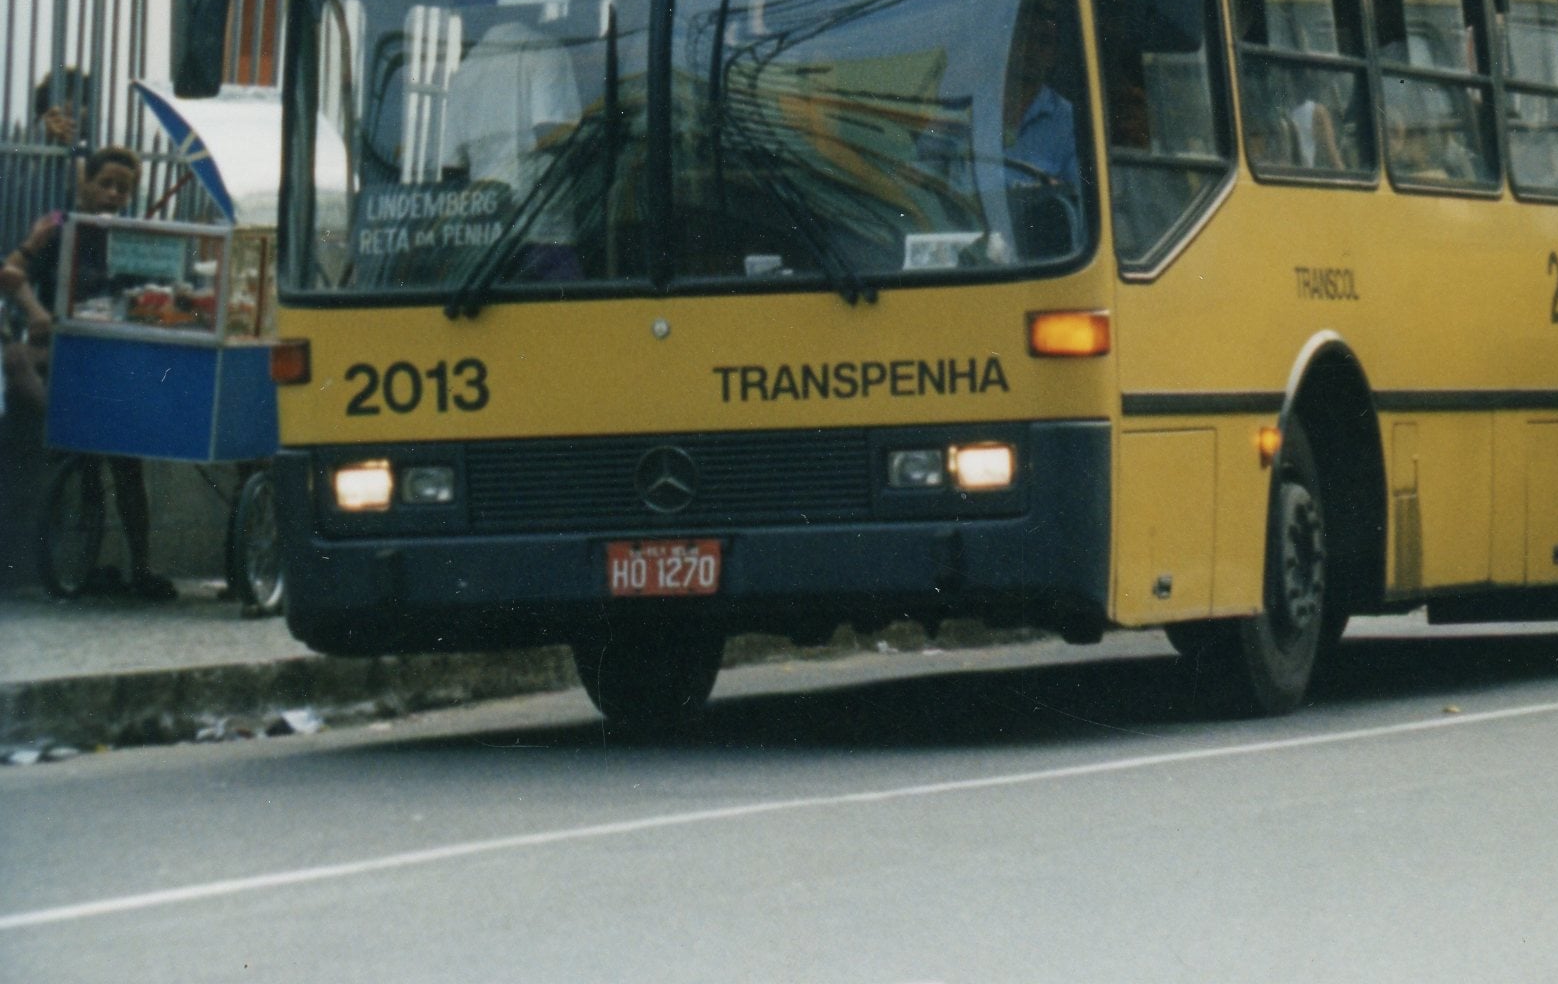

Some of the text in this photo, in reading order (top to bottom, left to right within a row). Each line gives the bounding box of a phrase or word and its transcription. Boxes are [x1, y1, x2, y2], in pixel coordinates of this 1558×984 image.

[366, 189, 498, 220] LINDEMBERG
[359, 227, 409, 255] RETA
[1293, 266, 1360, 301] TRANSCOL
[344, 358, 490, 417] 2013
[713, 357, 1010, 403] TRANSPENHA
[612, 554, 717, 590] HO 1270
